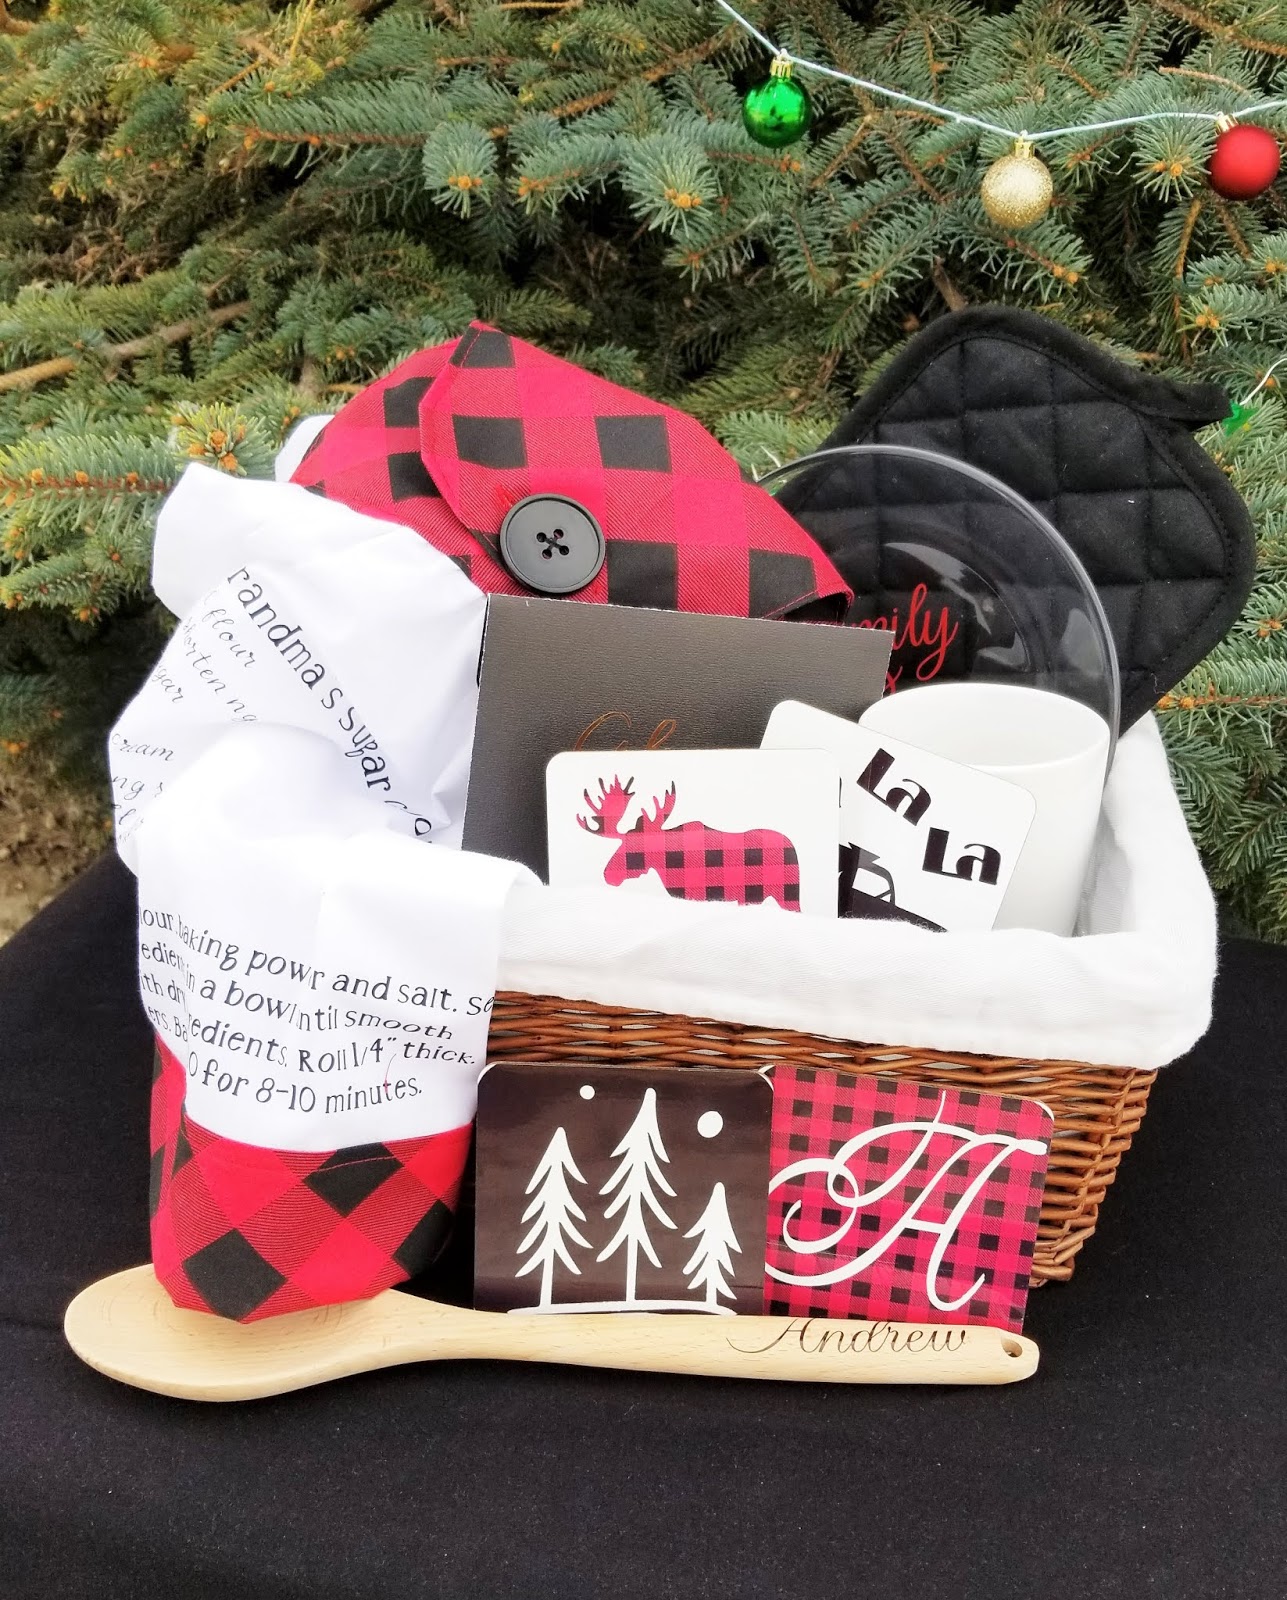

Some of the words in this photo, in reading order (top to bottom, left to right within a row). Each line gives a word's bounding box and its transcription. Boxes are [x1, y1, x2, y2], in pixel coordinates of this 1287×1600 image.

[856, 747, 932, 826] La
[922, 827, 1002, 886] La
[199, 979, 217, 1001] a
[344, 1010, 453, 1040] smooth
[332, 976, 392, 1001] and
[397, 984, 457, 1013] salt.
[403, 1041, 475, 1065] thick.
[202, 1058, 249, 1097] for
[255, 1076, 316, 1113] 8-10
[324, 1077, 423, 1114] minutes.
[725, 1316, 967, 1355] Andrew
